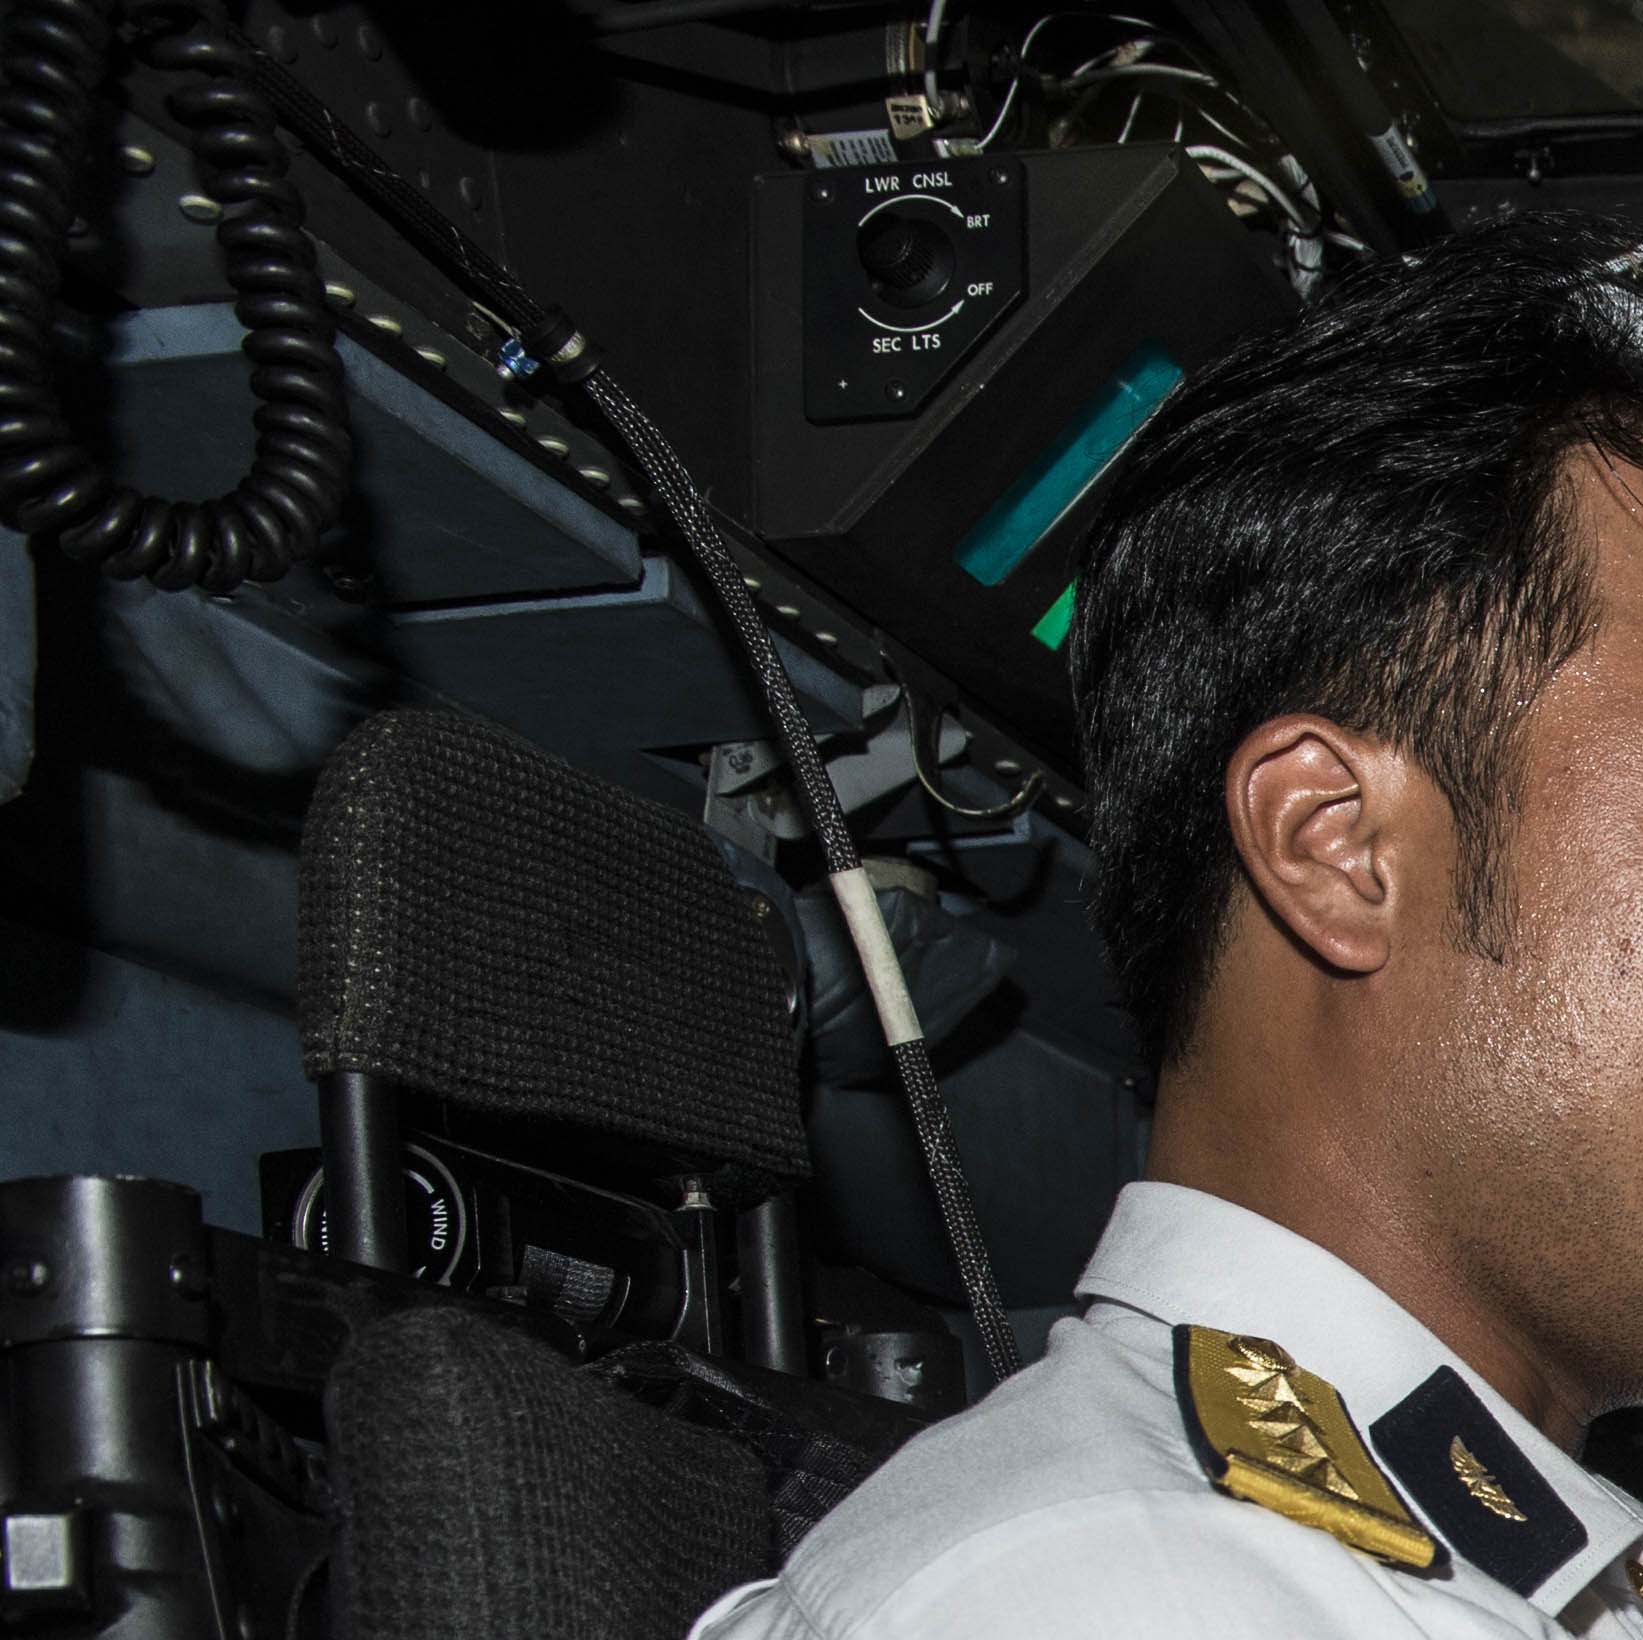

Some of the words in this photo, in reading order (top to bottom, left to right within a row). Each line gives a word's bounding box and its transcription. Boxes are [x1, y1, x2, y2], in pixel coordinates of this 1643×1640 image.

[865, 177, 900, 193] LWR
[912, 172, 953, 189] CNSL
[966, 213, 991, 229] BRT
[966, 281, 994, 297] OFF
[872, 337, 902, 354] SEC
[912, 334, 942, 350] LTS
[430, 1197, 447, 1253] WIND
